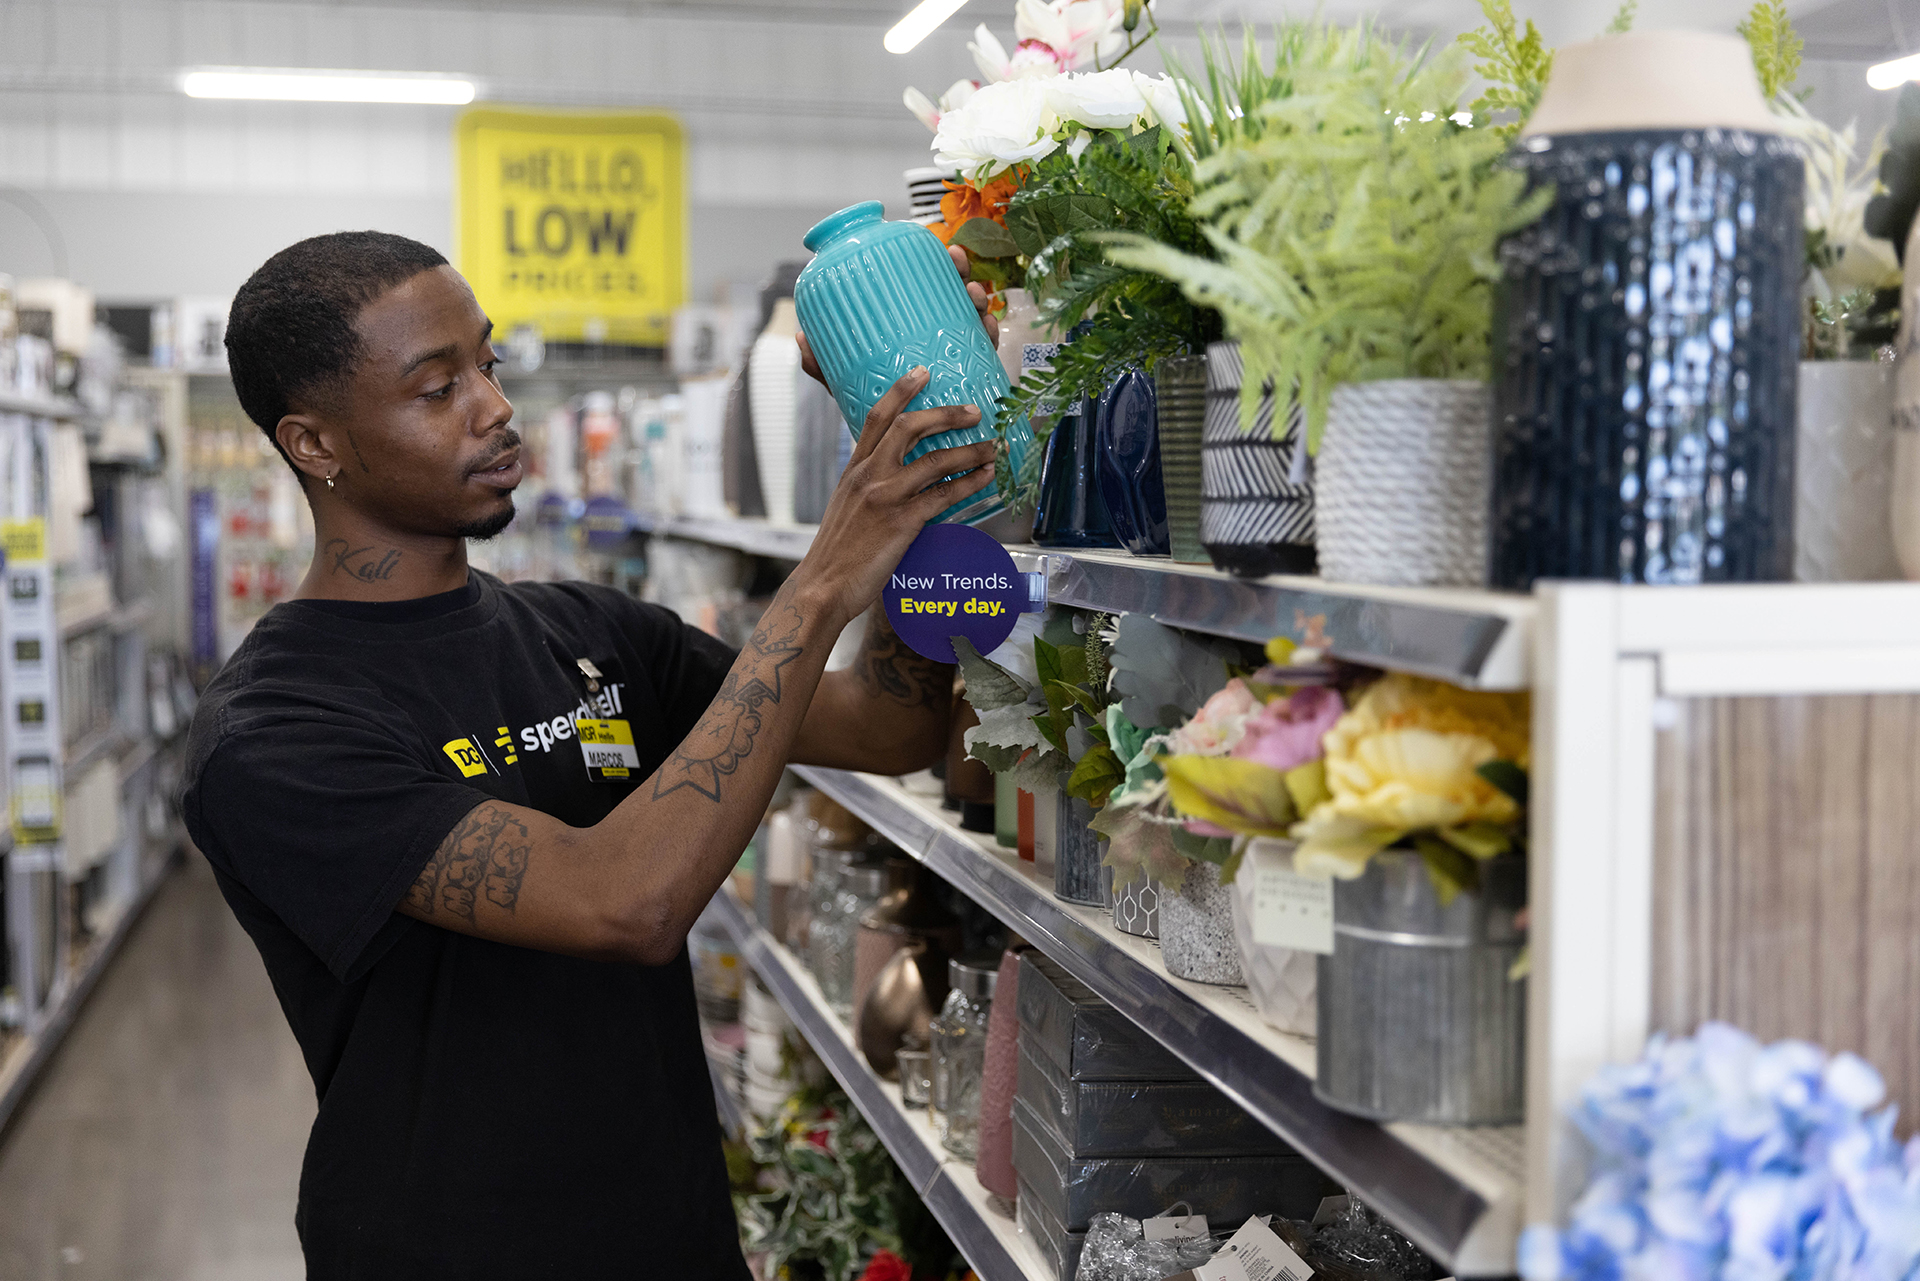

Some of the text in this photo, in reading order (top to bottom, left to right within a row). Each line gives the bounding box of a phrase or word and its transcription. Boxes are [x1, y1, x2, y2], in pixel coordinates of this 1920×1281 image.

[503, 206, 637, 258] LOW
[892, 573, 1013, 590] New Trends.
[900, 597, 1006, 617] Every day.
[588, 750, 625, 768] MARCOS
